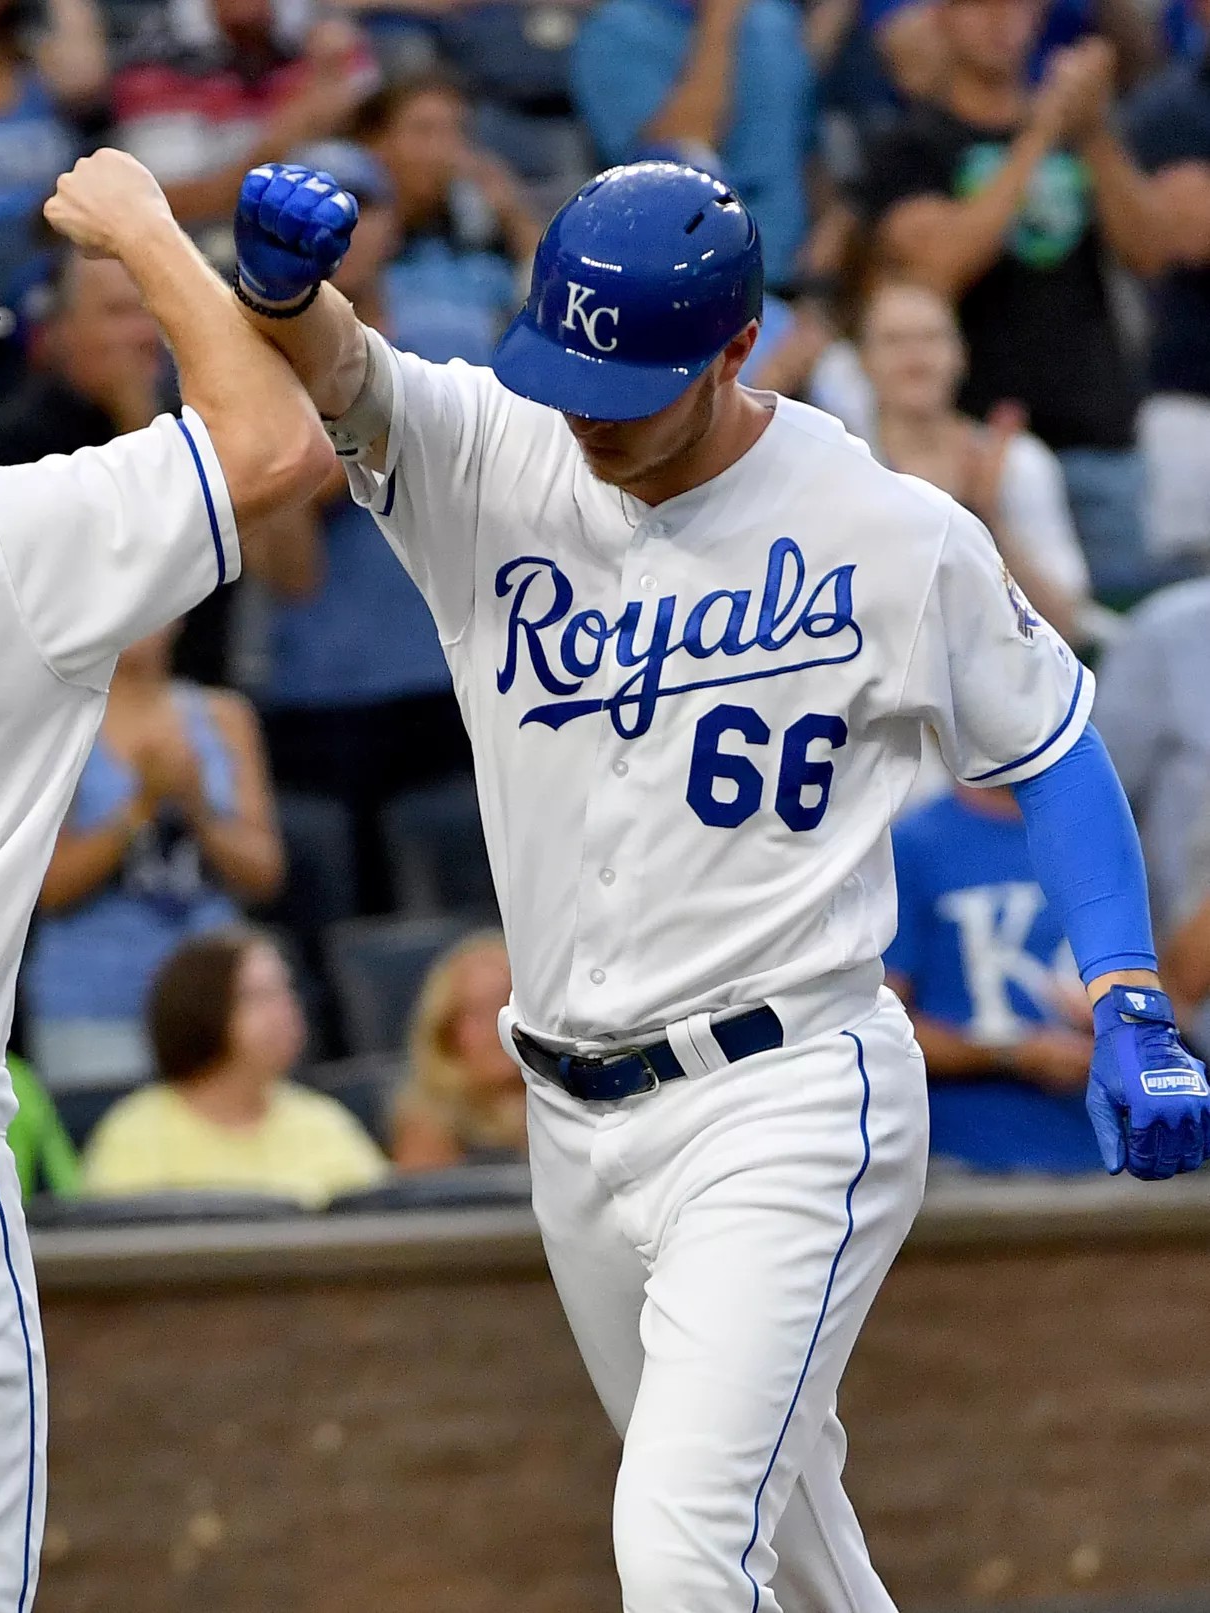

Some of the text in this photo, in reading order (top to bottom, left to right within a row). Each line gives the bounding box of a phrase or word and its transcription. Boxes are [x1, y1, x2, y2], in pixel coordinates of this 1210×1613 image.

[562, 281, 619, 352] KC
[494, 537, 862, 740] Royals
[686, 703, 848, 832] 66
[937, 880, 1087, 1047] K
